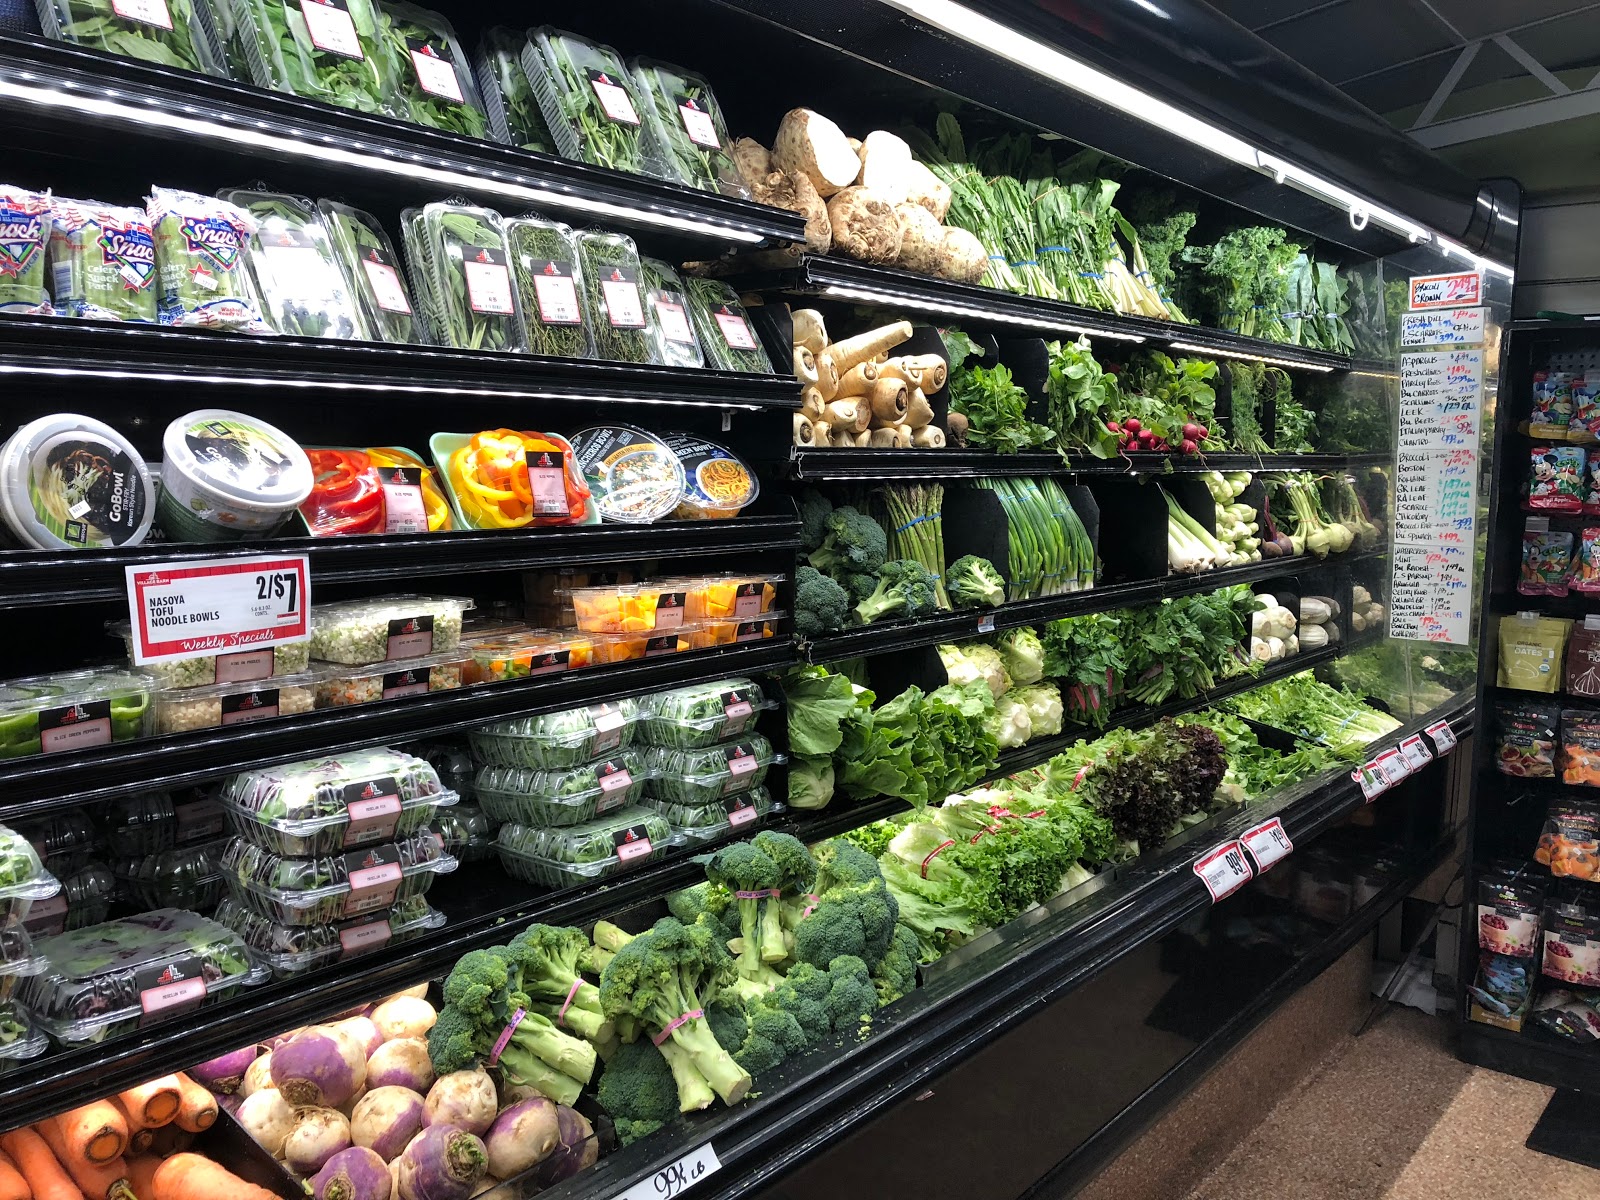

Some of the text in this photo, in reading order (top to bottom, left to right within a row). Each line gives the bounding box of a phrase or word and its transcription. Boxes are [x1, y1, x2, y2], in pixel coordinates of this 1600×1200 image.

[0, 215, 42, 239] nack
[107, 235, 154, 260] Snac
[87, 265, 120, 276] Celery
[160, 263, 187, 275] Celery
[87, 274, 119, 284] Snack
[161, 271, 187, 281] Snack
[87, 282, 114, 291] Pack
[162, 280, 184, 290] Pack
[1400, 407, 1424, 417] LEEK
[1398, 464, 1426, 473] BOSTON
[109, 471, 124, 522] GoBowl
[149, 594, 185, 608] NASOYA
[149, 606, 174, 618] TOFU
[151, 610, 220, 628] NOODLE BOWLS
[180, 628, 275, 651] Weekly Specials
[1516, 640, 1542, 648] ORGANIC
[1514, 647, 1543, 657] DATES
